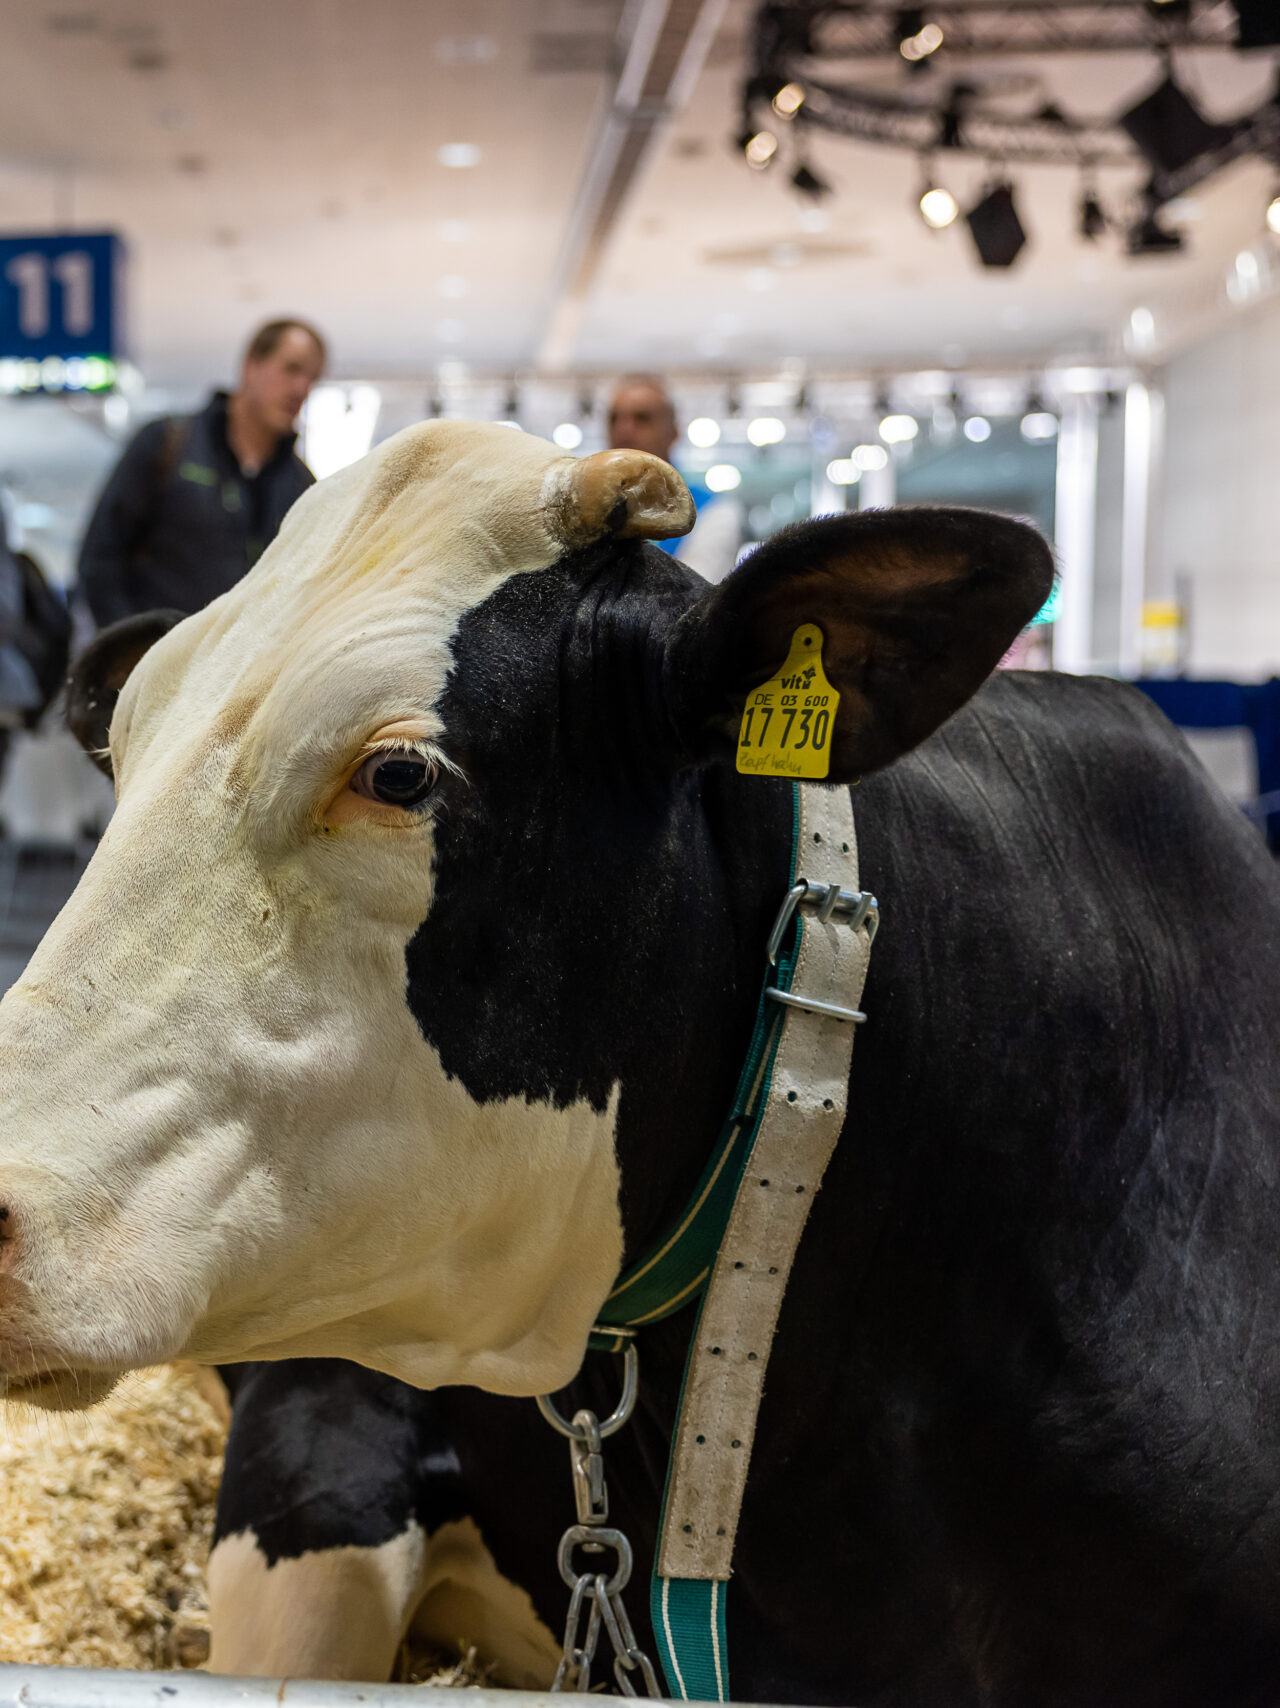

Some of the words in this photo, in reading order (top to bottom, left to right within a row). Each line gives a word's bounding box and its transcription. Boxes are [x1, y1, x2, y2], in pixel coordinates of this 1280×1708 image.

[6, 250, 95, 340] 11
[781, 674, 802, 690] vit
[754, 693, 775, 706] DE
[780, 695, 798, 706] 03
[804, 695, 829, 707] 600
